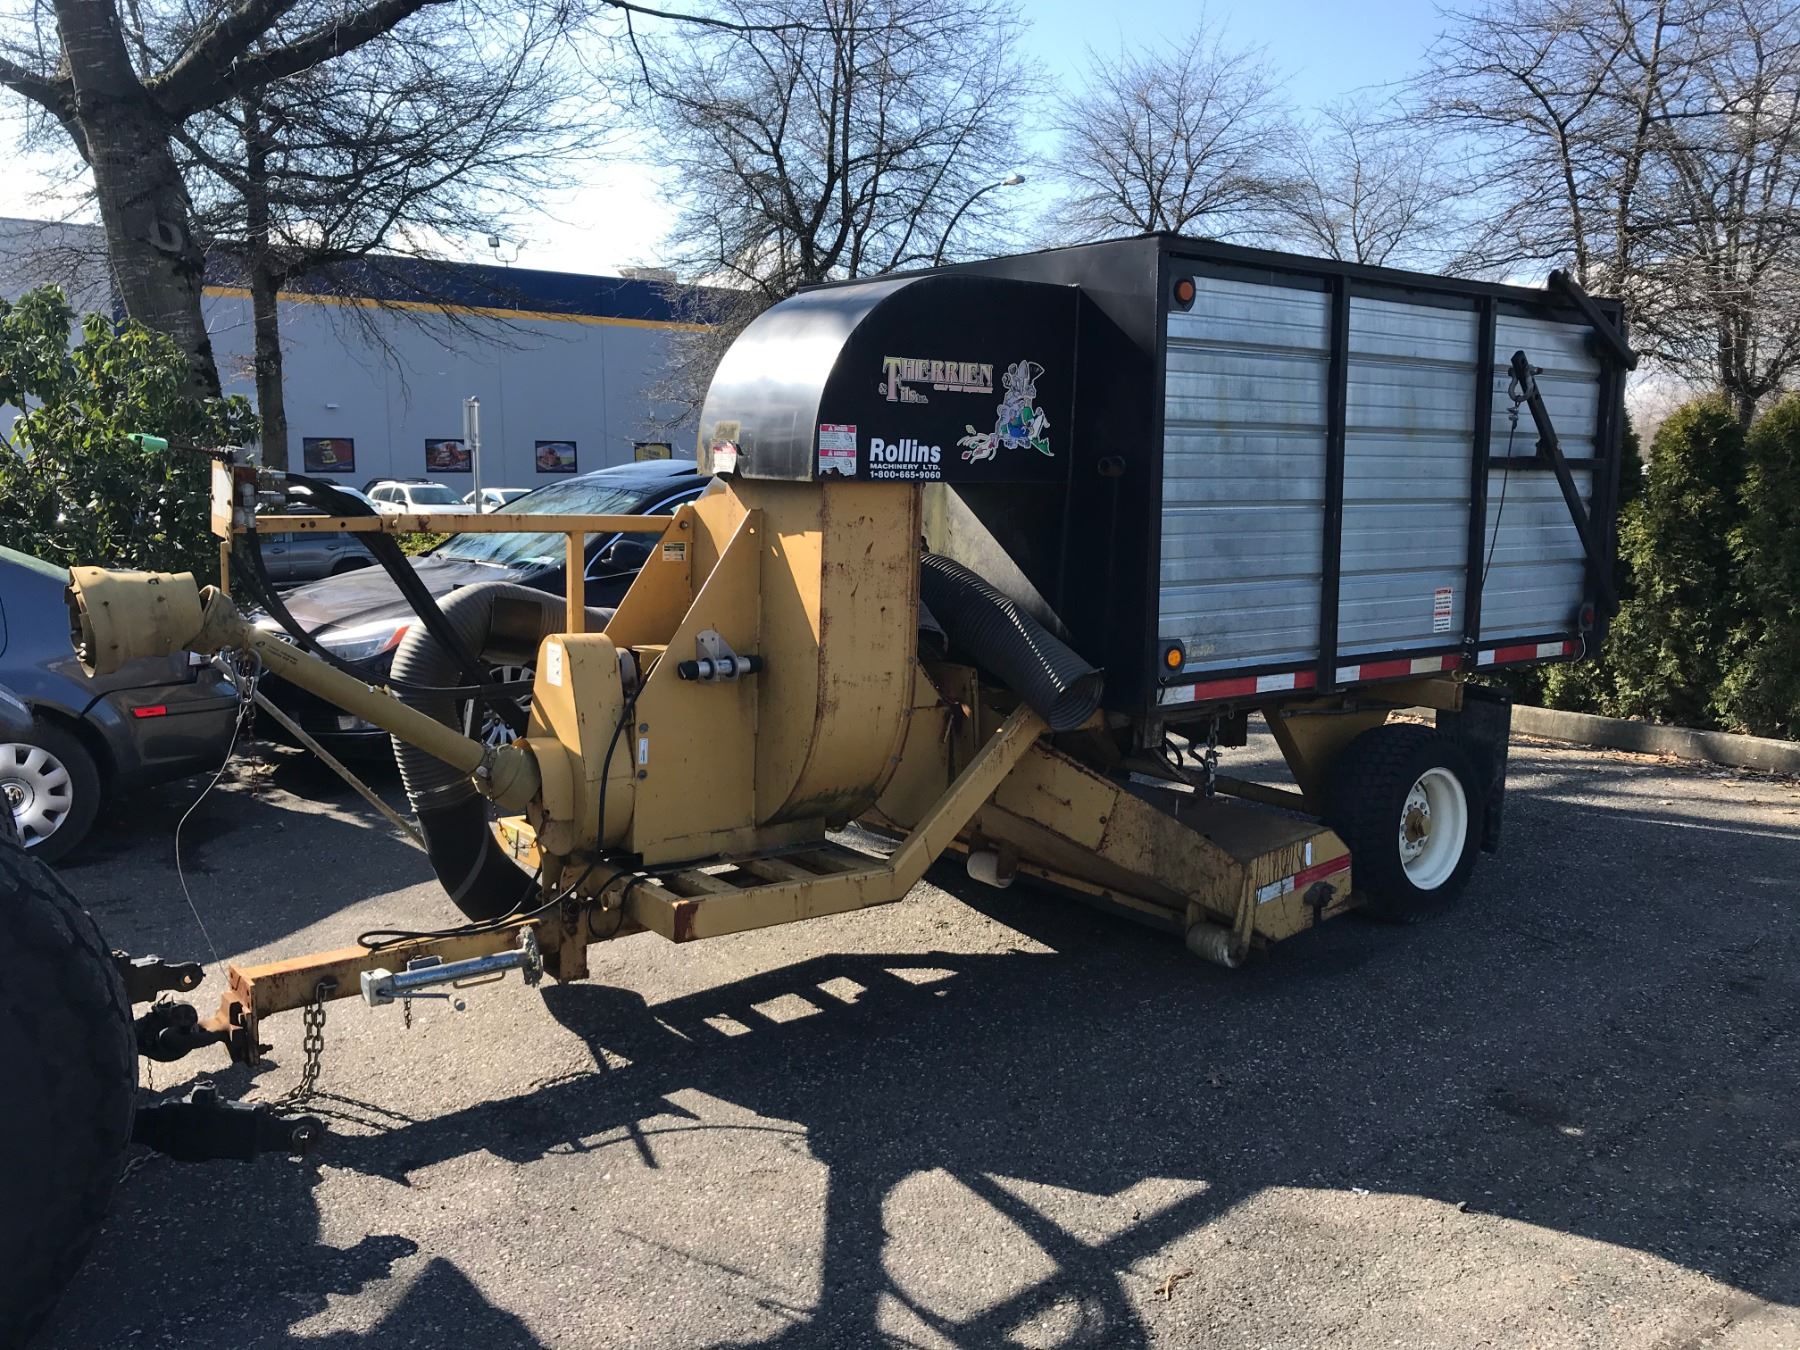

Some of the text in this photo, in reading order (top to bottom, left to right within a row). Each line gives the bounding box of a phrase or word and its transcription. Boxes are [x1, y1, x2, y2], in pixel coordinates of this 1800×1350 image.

[883, 356, 993, 401] THERRIEN
[870, 438, 941, 463] Rollins
[870, 471, 941, 479] 1-800-665-9060
